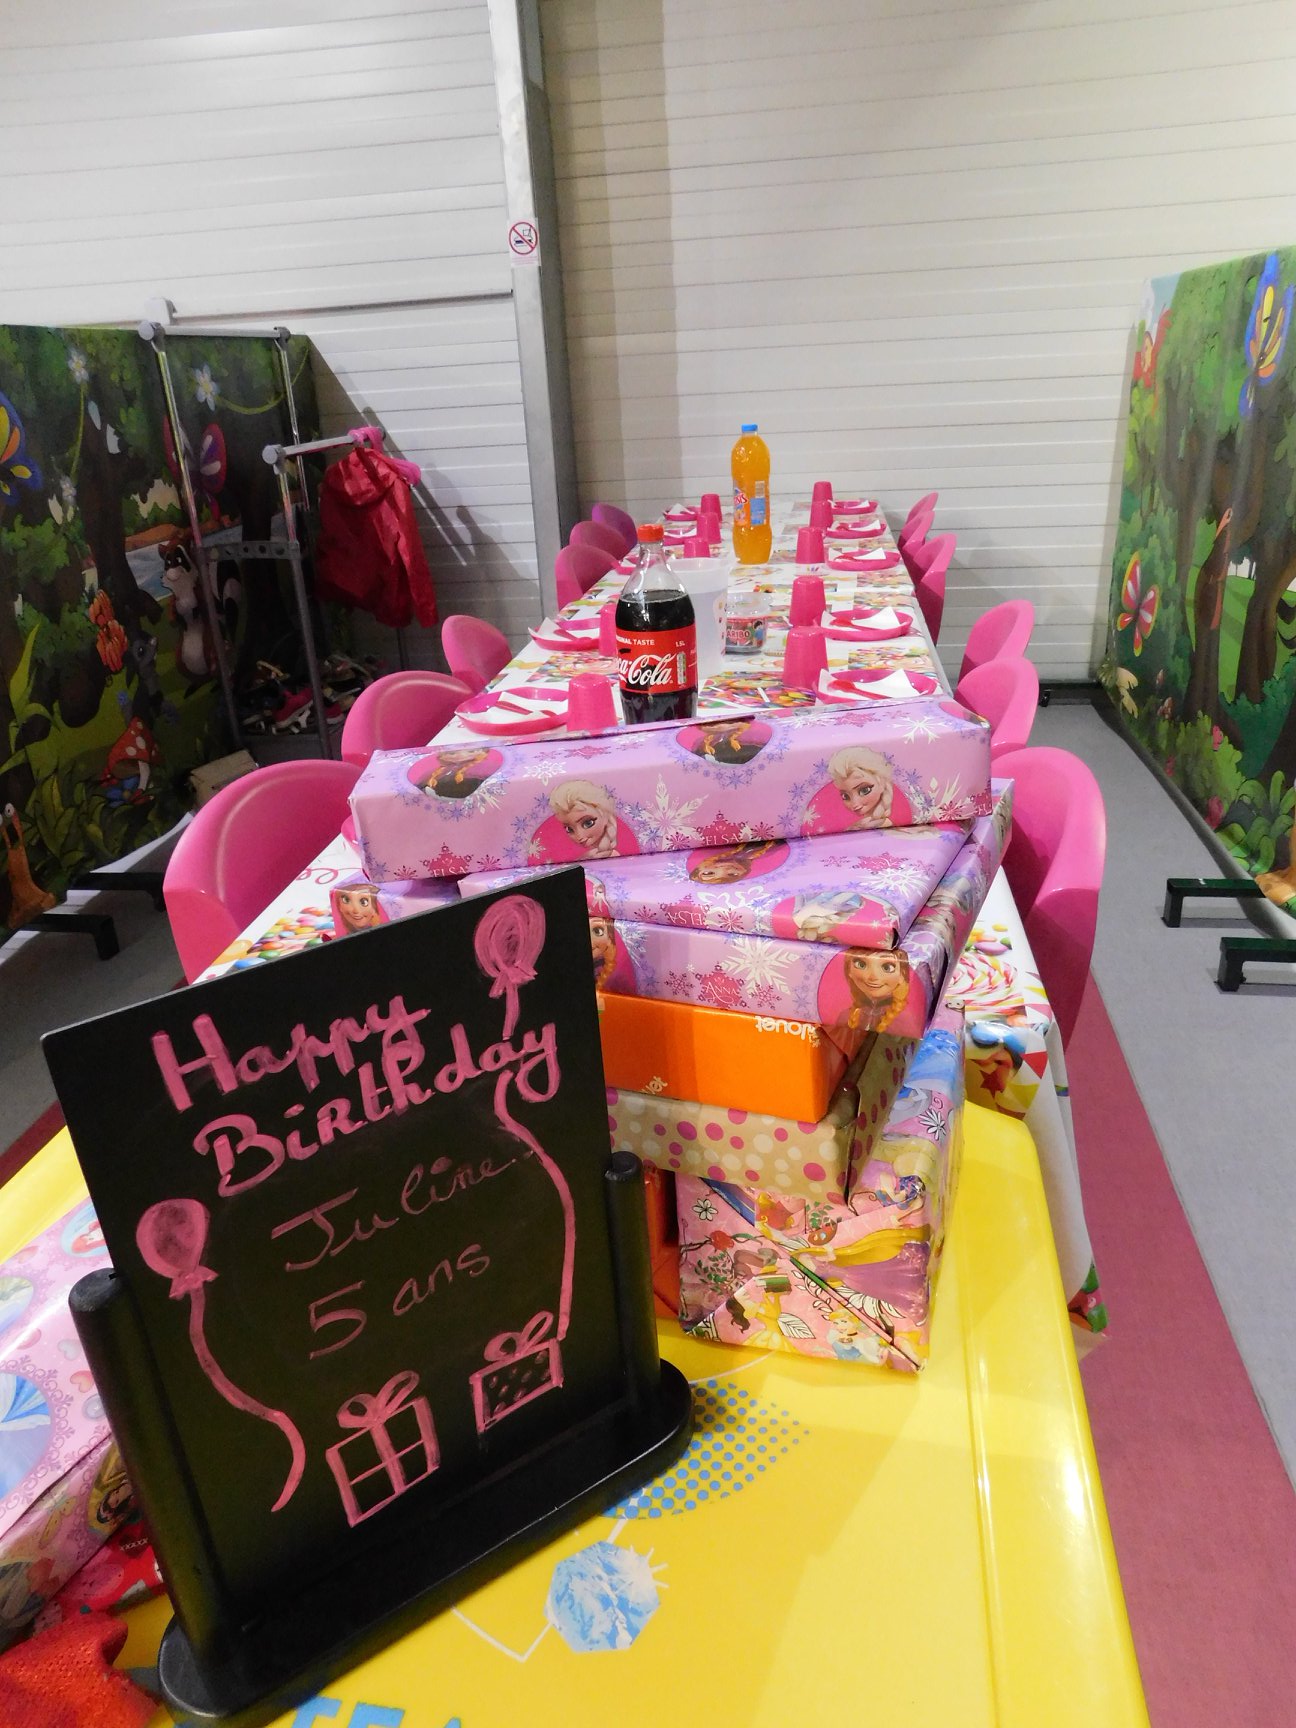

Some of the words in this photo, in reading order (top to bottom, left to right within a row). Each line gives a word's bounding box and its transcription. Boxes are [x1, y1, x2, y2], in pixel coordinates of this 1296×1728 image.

[727, 630, 751, 638] ARIBO
[667, 910, 703, 926] ELSA
[704, 981, 739, 1004] ANNA
[754, 1015, 812, 1041] Jouet
[151, 995, 432, 1113] Happy
[271, 1156, 516, 1273] Juline
[308, 1279, 368, 1361] 5
[392, 1243, 491, 1317] ans
